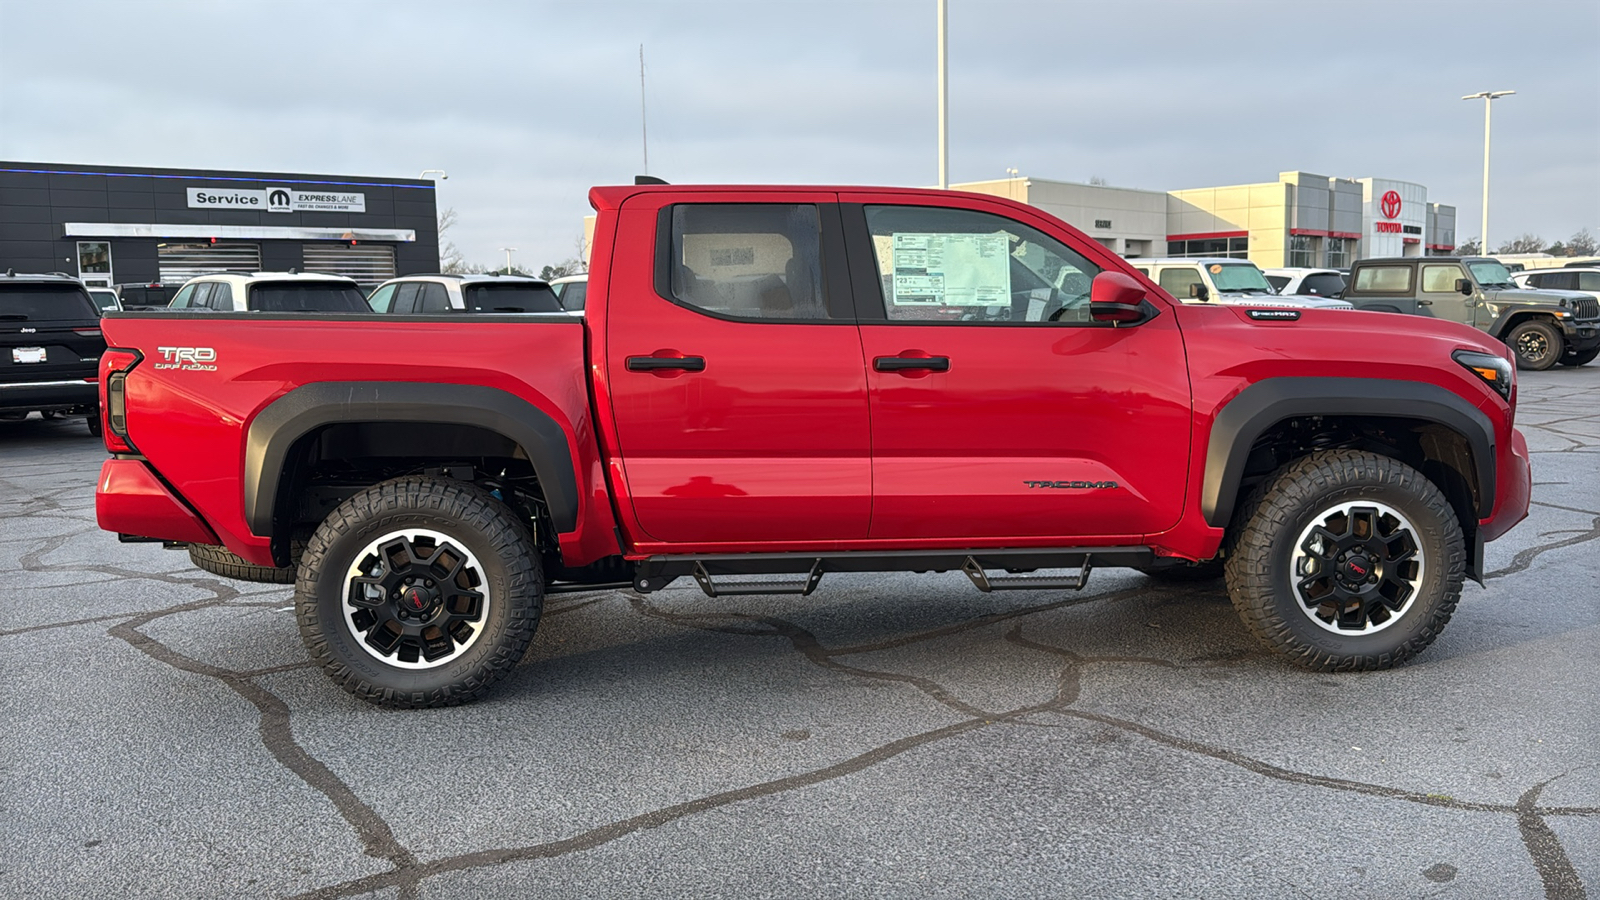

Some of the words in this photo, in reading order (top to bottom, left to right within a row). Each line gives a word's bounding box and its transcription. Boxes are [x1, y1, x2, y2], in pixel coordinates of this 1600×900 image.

[196, 192, 259, 205] Service
[1376, 221, 1403, 233] TOYOTA
[157, 346, 217, 364] TRD
[154, 362, 180, 370] OFF
[181, 363, 218, 371] ROAD
[1022, 480, 1119, 489] TACOMA
[1349, 562, 1366, 576] TRD
[412, 589, 423, 609] TRD
